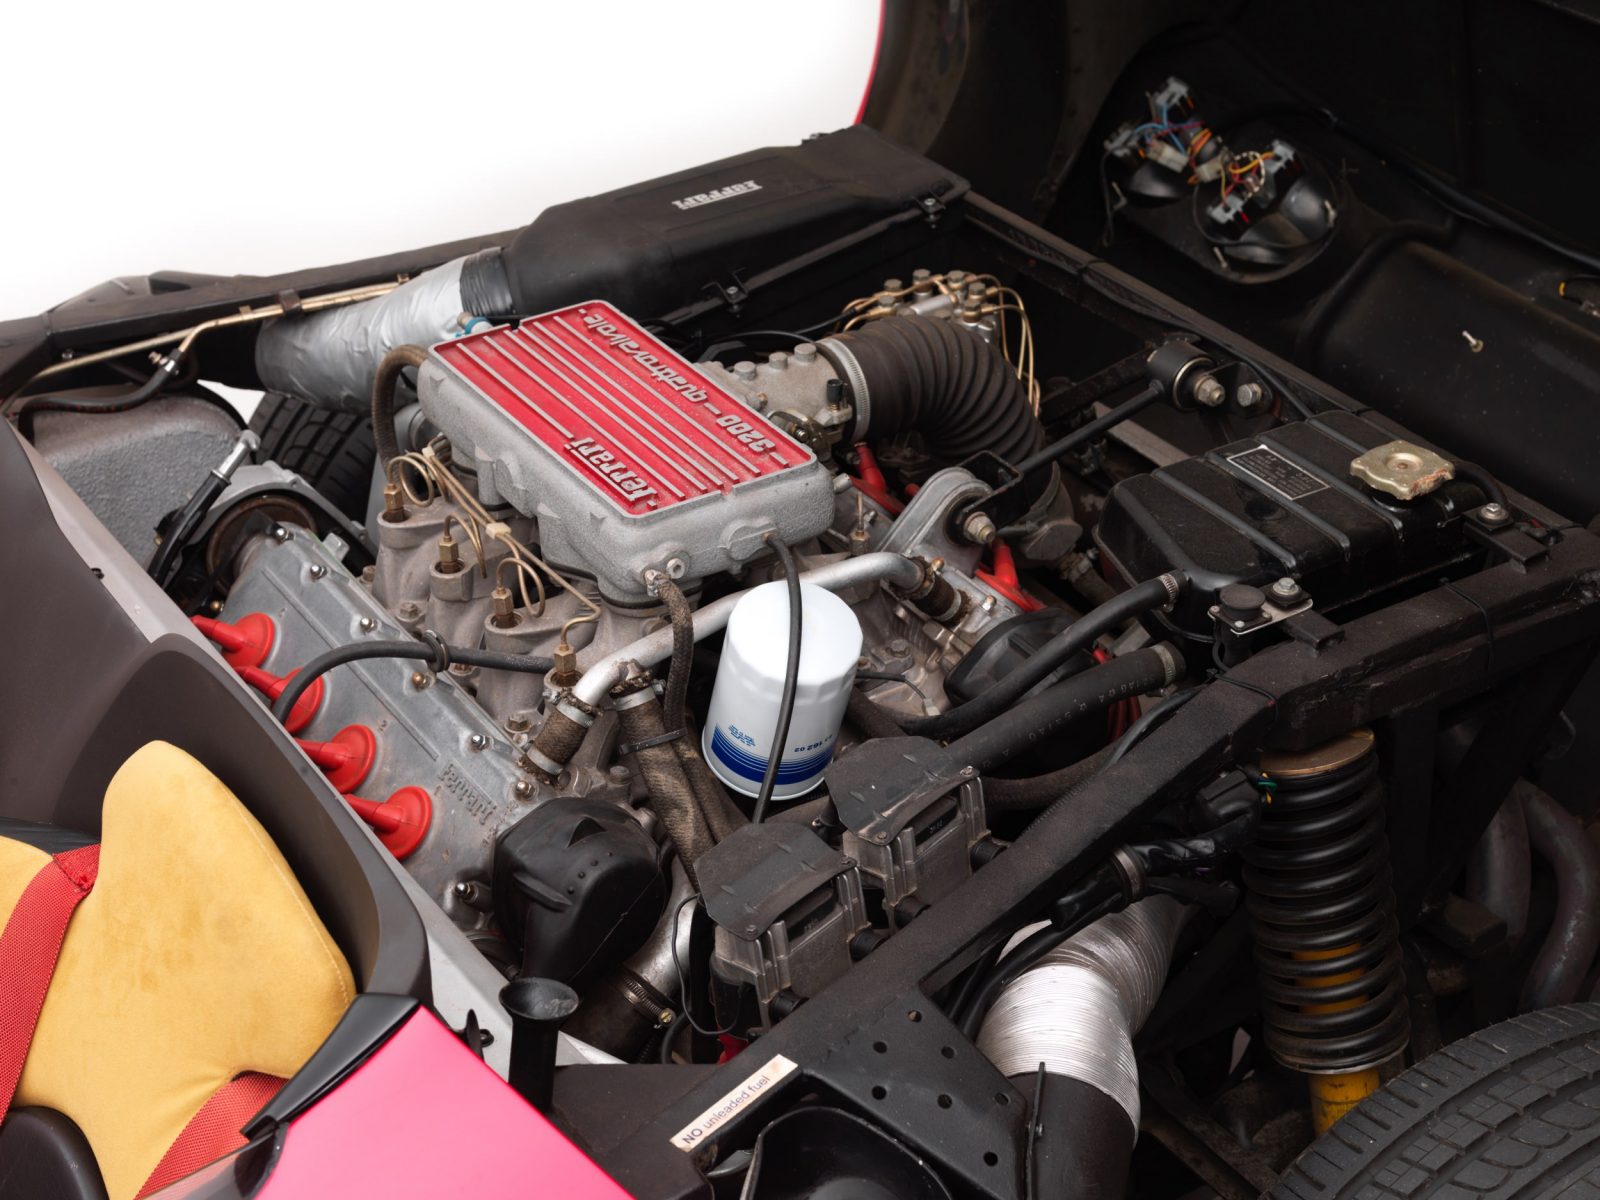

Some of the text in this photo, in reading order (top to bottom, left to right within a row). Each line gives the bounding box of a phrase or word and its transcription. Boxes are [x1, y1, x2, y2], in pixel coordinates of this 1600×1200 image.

[583, 312, 776, 453] 3200 quattrovalvole
[681, 1074, 771, 1145] NO unleaded fuel
